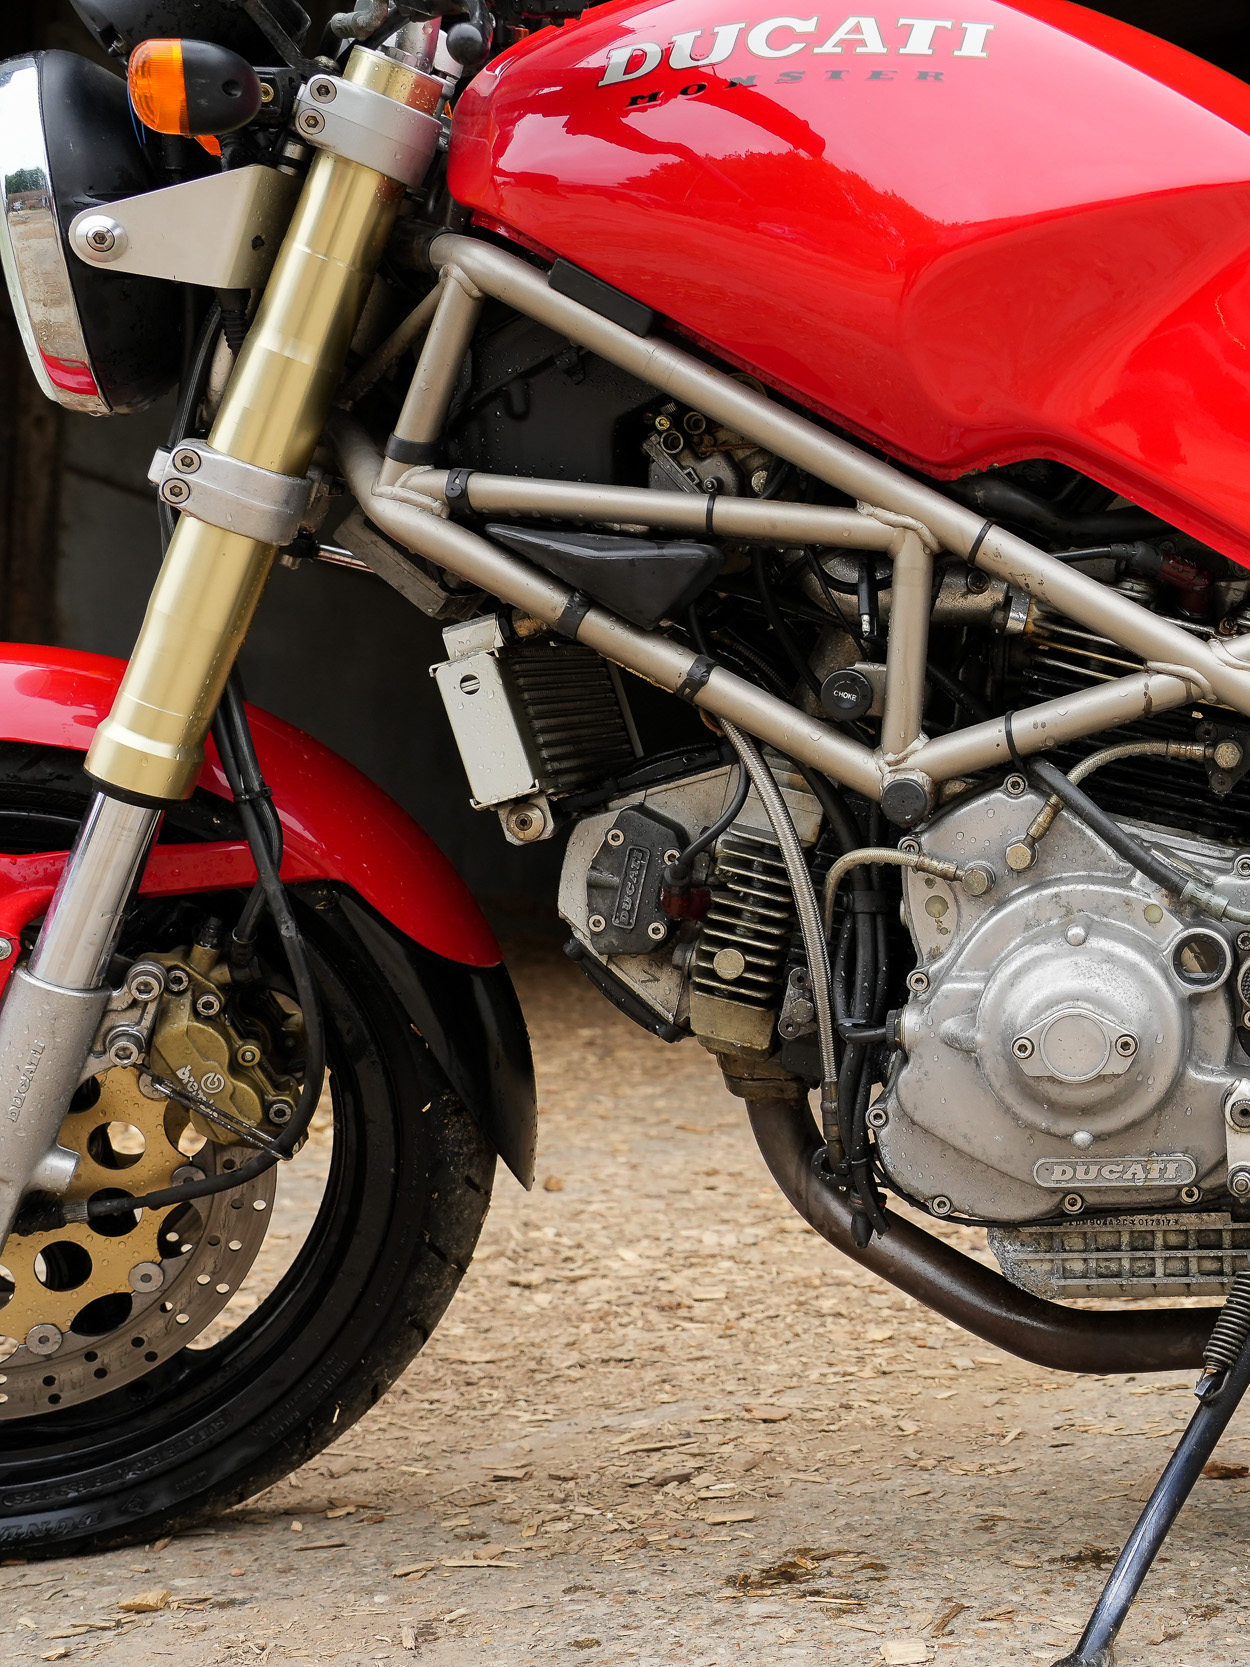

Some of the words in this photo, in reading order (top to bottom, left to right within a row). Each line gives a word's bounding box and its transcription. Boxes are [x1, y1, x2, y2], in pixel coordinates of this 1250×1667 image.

[598, 15, 996, 88] DUCATI
[627, 69, 946, 107] MONSTER
[833, 689, 858, 702] CHOKE
[618, 849, 645, 925] DUCATI
[5, 1039, 46, 1123] DUCATI
[1050, 1162, 1179, 1181] DUCATI
